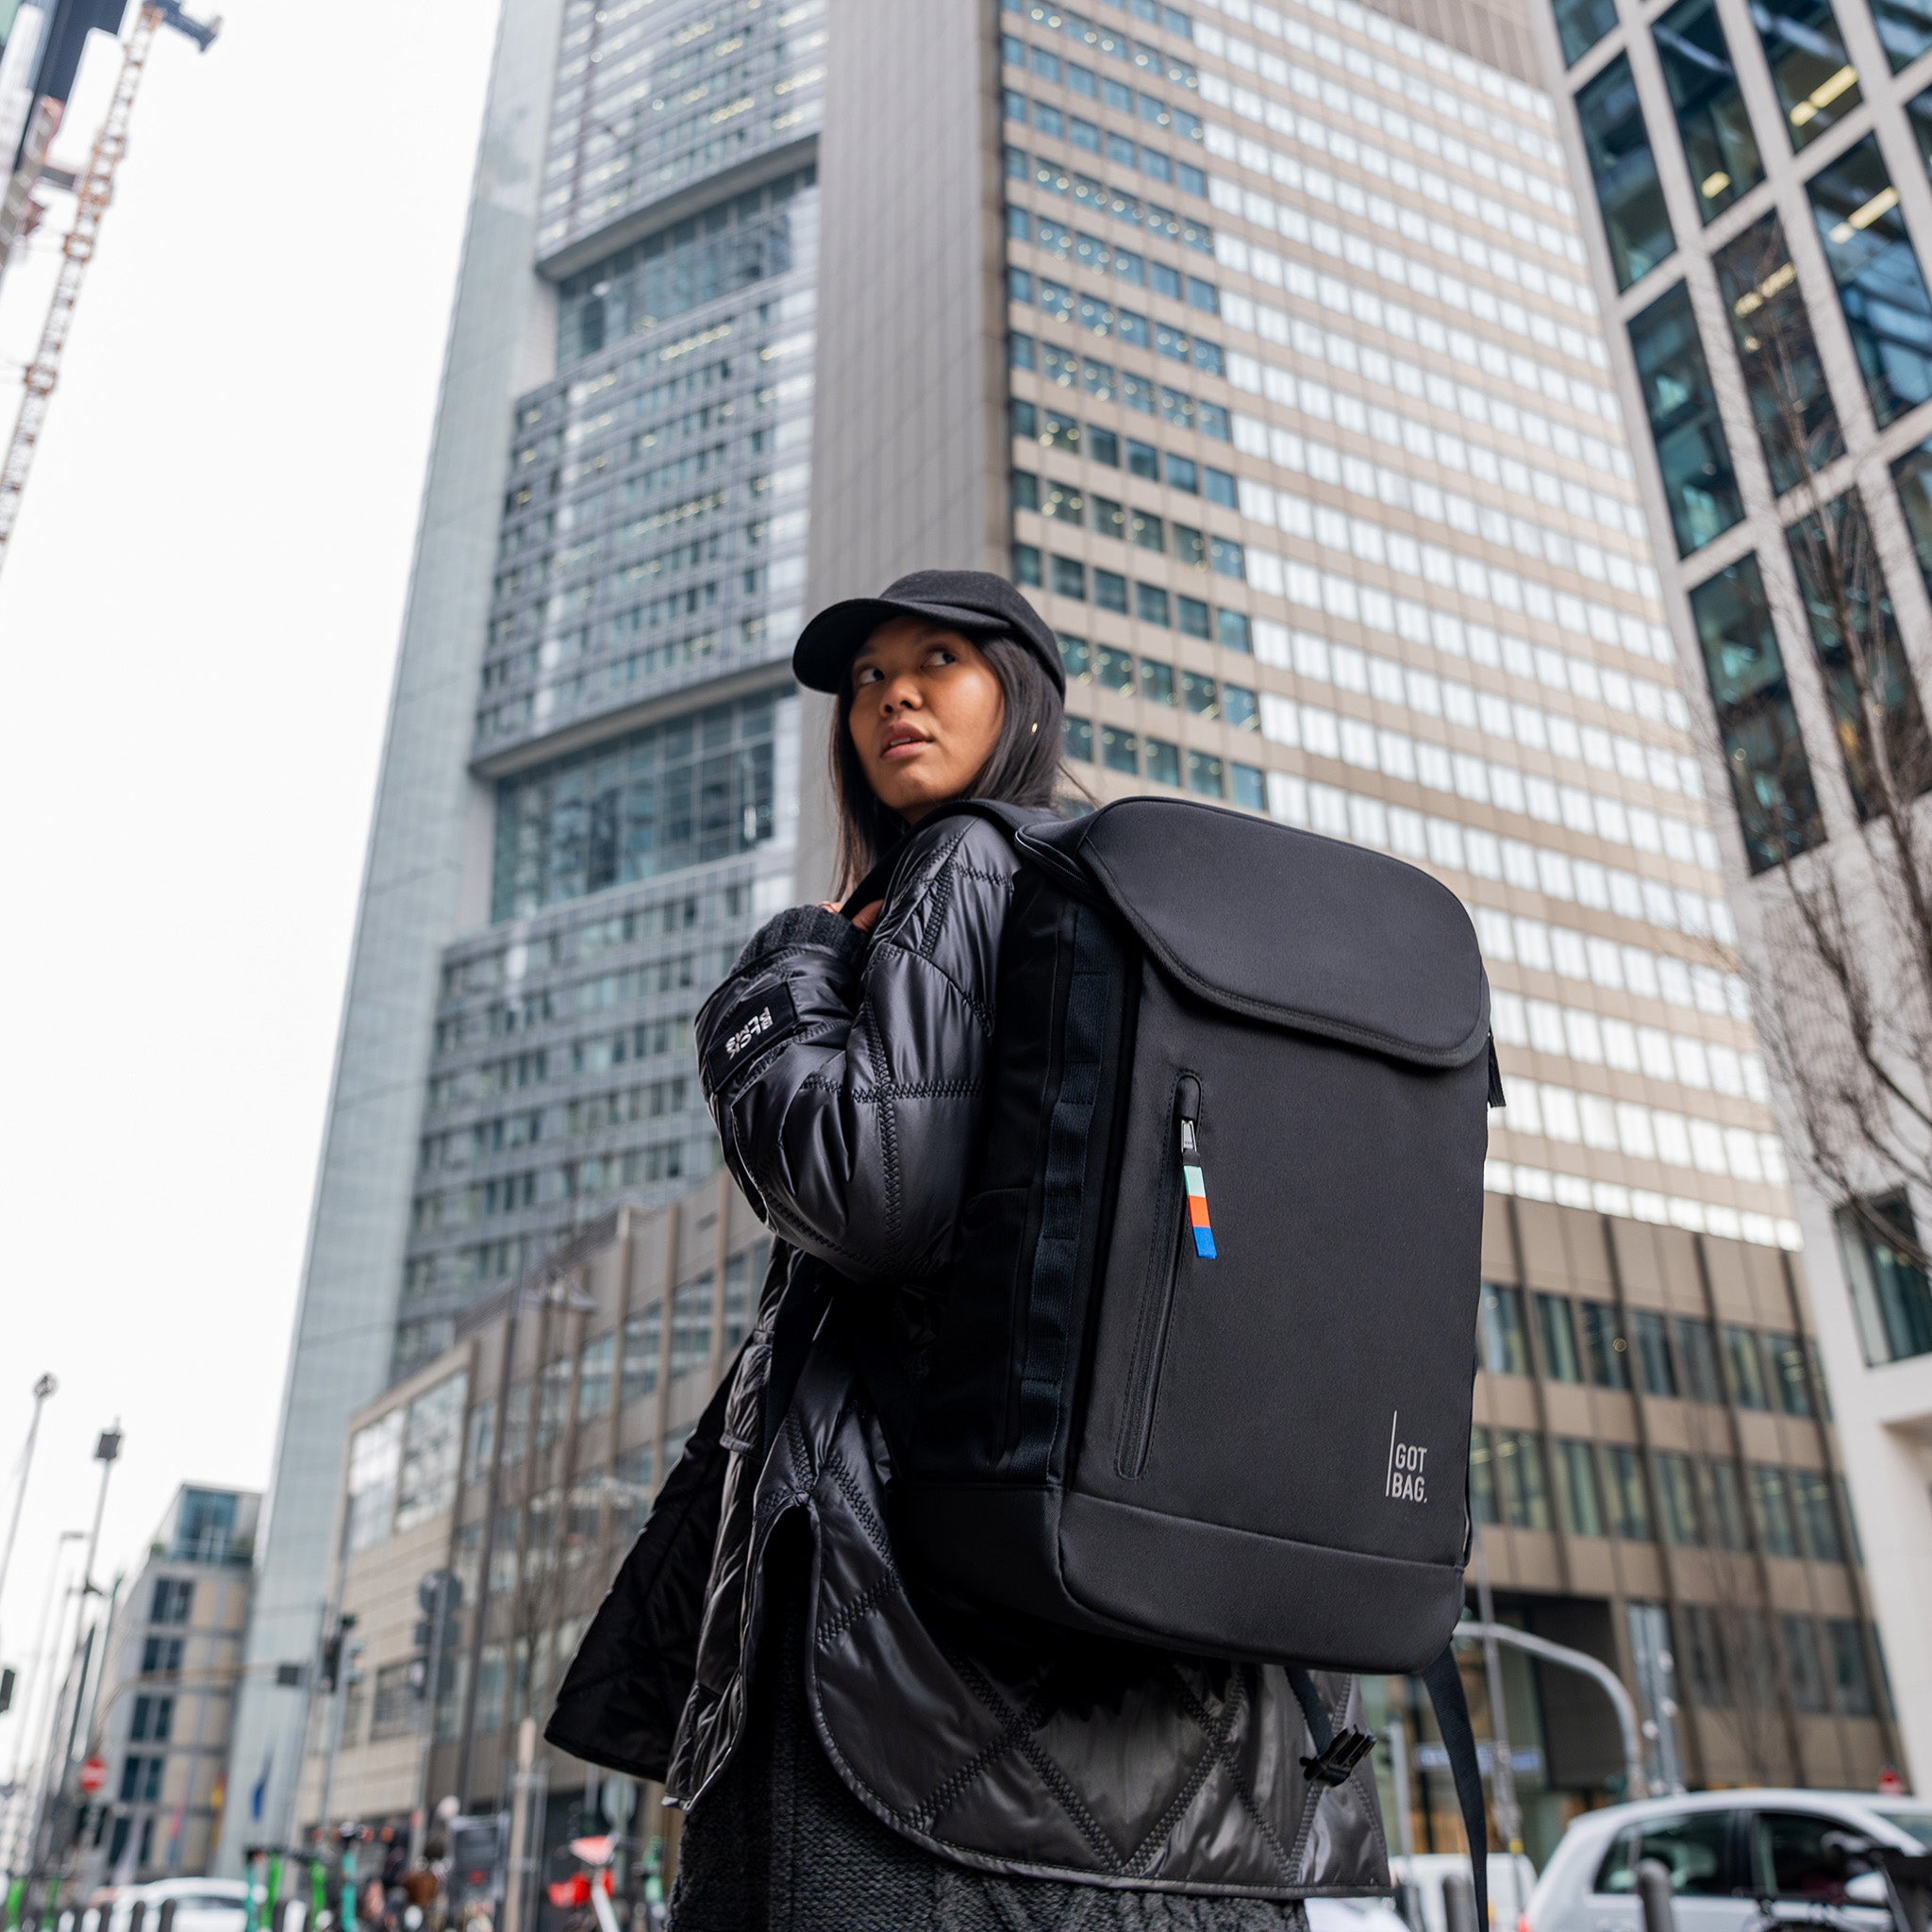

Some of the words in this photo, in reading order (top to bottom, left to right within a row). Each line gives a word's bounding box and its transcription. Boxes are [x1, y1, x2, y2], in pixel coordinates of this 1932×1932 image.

[725, 1006, 771, 1052] PLMS
[727, 1015, 774, 1060] BLCK
[1394, 1442, 1428, 1474] GOT
[1391, 1472, 1428, 1504] BAG.
